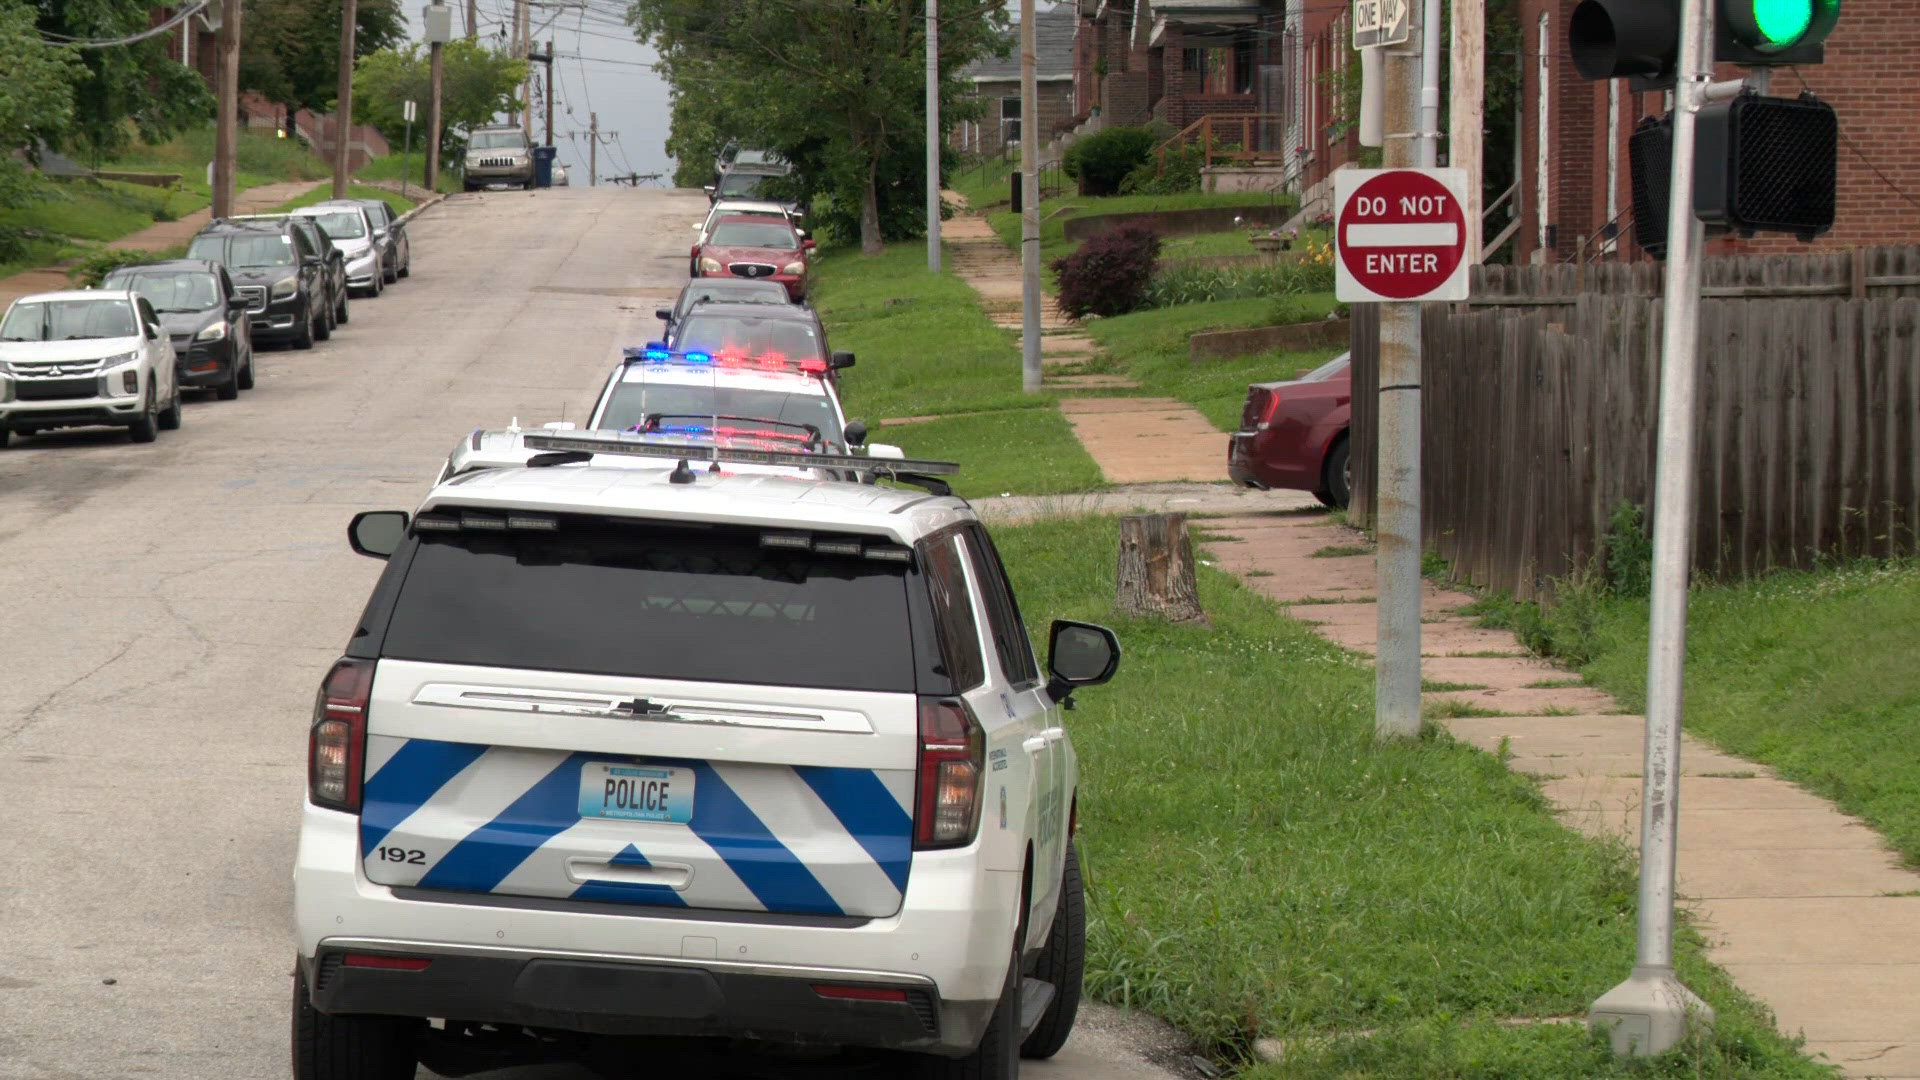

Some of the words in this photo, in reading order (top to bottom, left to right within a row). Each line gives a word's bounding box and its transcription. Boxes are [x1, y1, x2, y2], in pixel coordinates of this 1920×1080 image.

[1358, 2, 1376, 27] ONE
[1382, 0, 1398, 23] WAY
[1357, 196, 1387, 216] DO
[1401, 195, 1446, 216] NOT
[1366, 253, 1438, 274] ENTER
[604, 779, 670, 811] POLICE
[379, 846, 426, 865] 192
